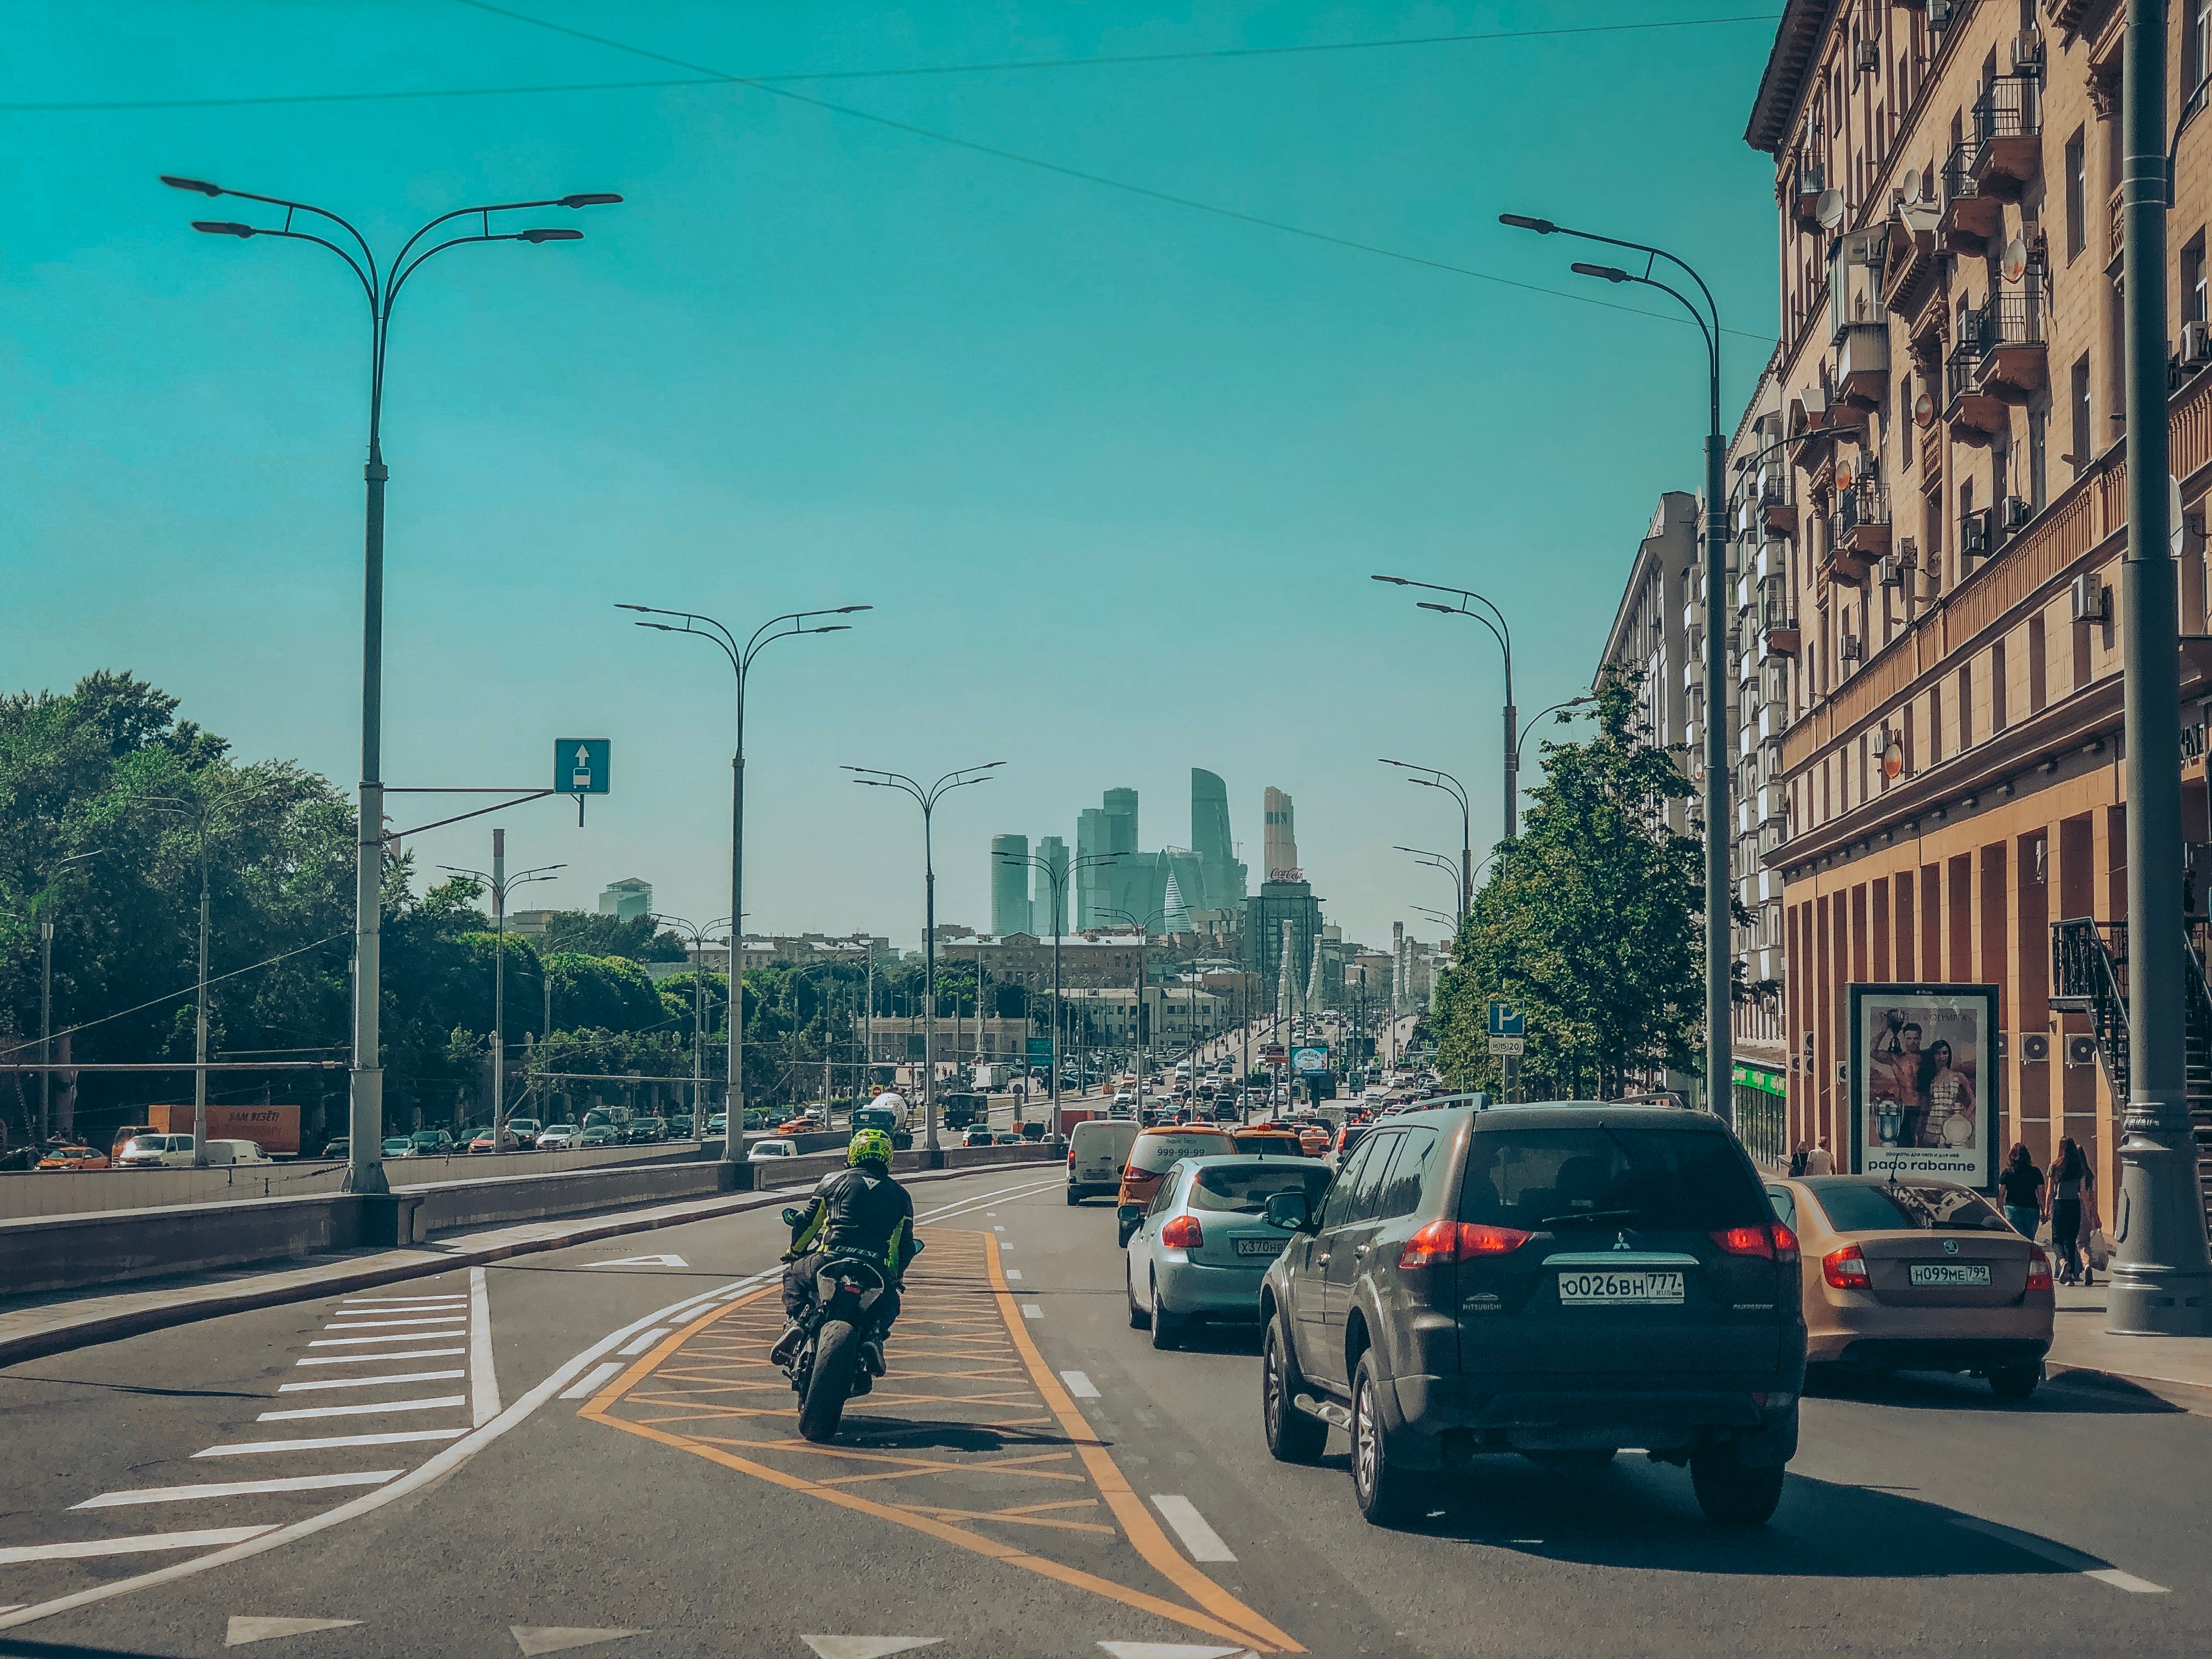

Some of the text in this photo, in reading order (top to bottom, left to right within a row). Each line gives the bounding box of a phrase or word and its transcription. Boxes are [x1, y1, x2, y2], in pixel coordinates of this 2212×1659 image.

[1499, 1003, 1520, 1030] P
[1157, 1148, 1205, 1156] 999-99-99
[1868, 1159, 1976, 1172] paco rabanne
[1967, 1266, 1986, 1277] 799
[1647, 1273, 1678, 1290] 777
